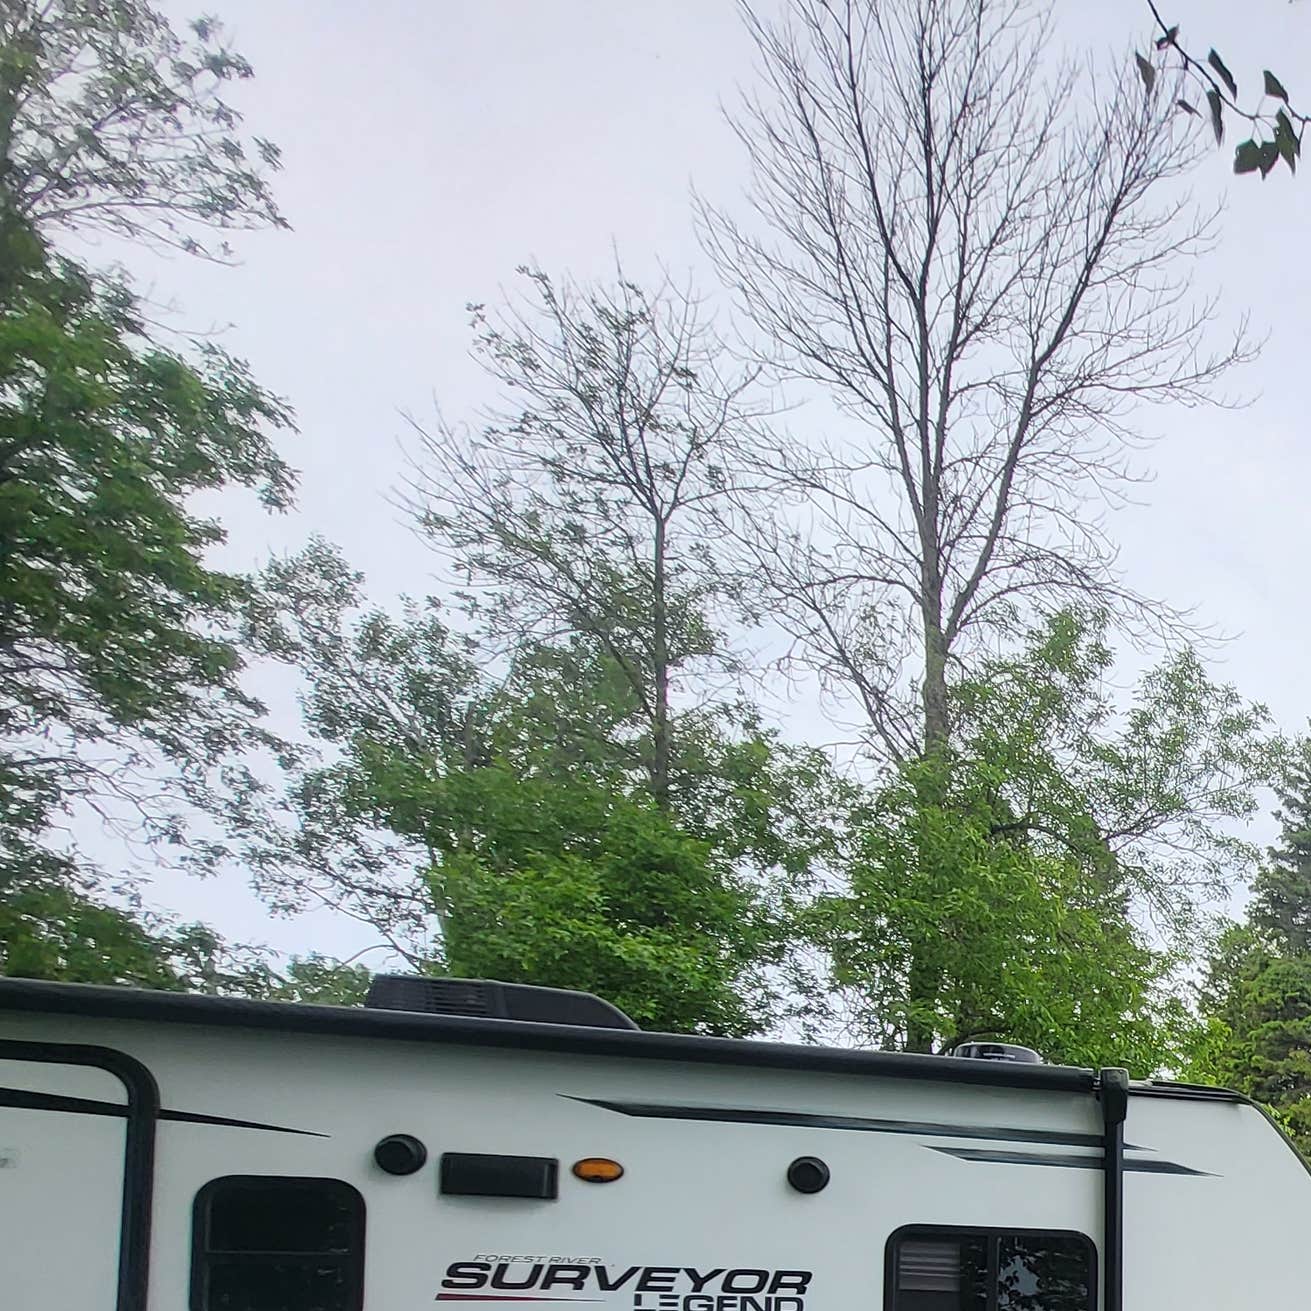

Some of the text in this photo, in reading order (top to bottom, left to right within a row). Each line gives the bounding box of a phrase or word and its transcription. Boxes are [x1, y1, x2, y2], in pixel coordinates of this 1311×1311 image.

[473, 1254, 602, 1264] FOREST RIVER
[441, 1262, 813, 1294] SURVEYOR
